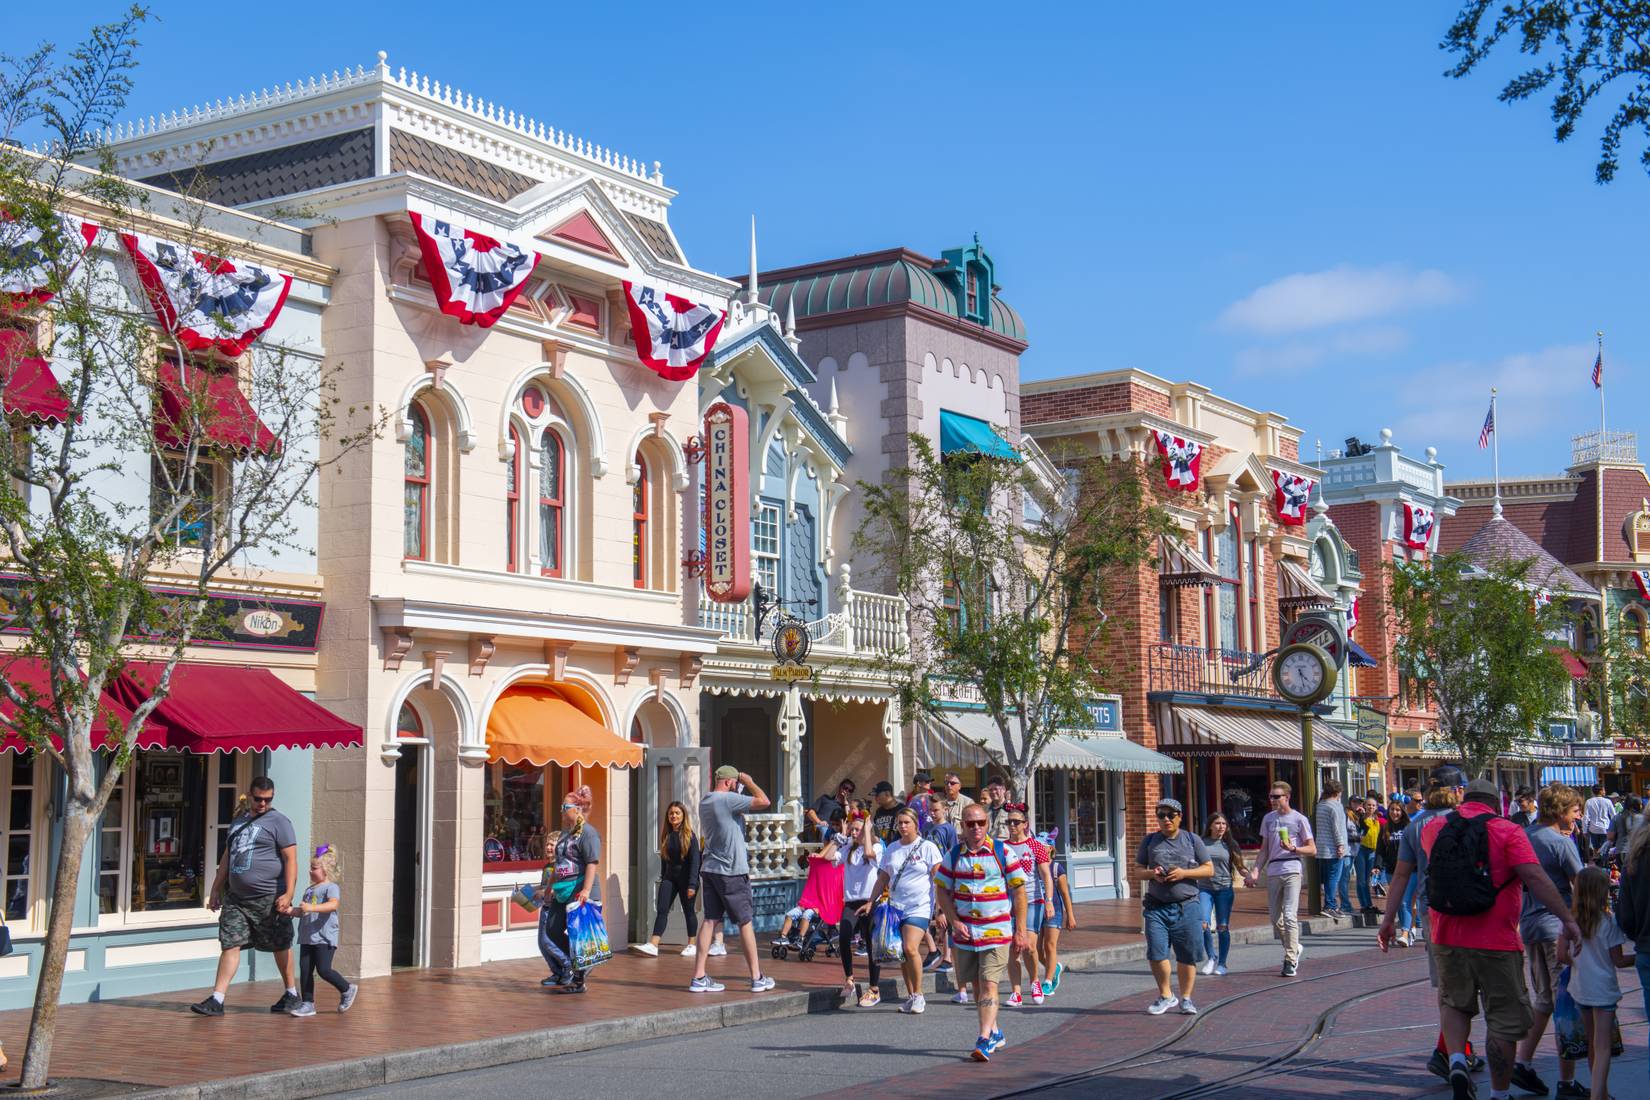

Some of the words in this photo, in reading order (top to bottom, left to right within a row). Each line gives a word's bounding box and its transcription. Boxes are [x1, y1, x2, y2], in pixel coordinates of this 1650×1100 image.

[715, 430, 726, 492] CHINA
[715, 499, 727, 576] CLOSET
[250, 615, 278, 630] Nikon
